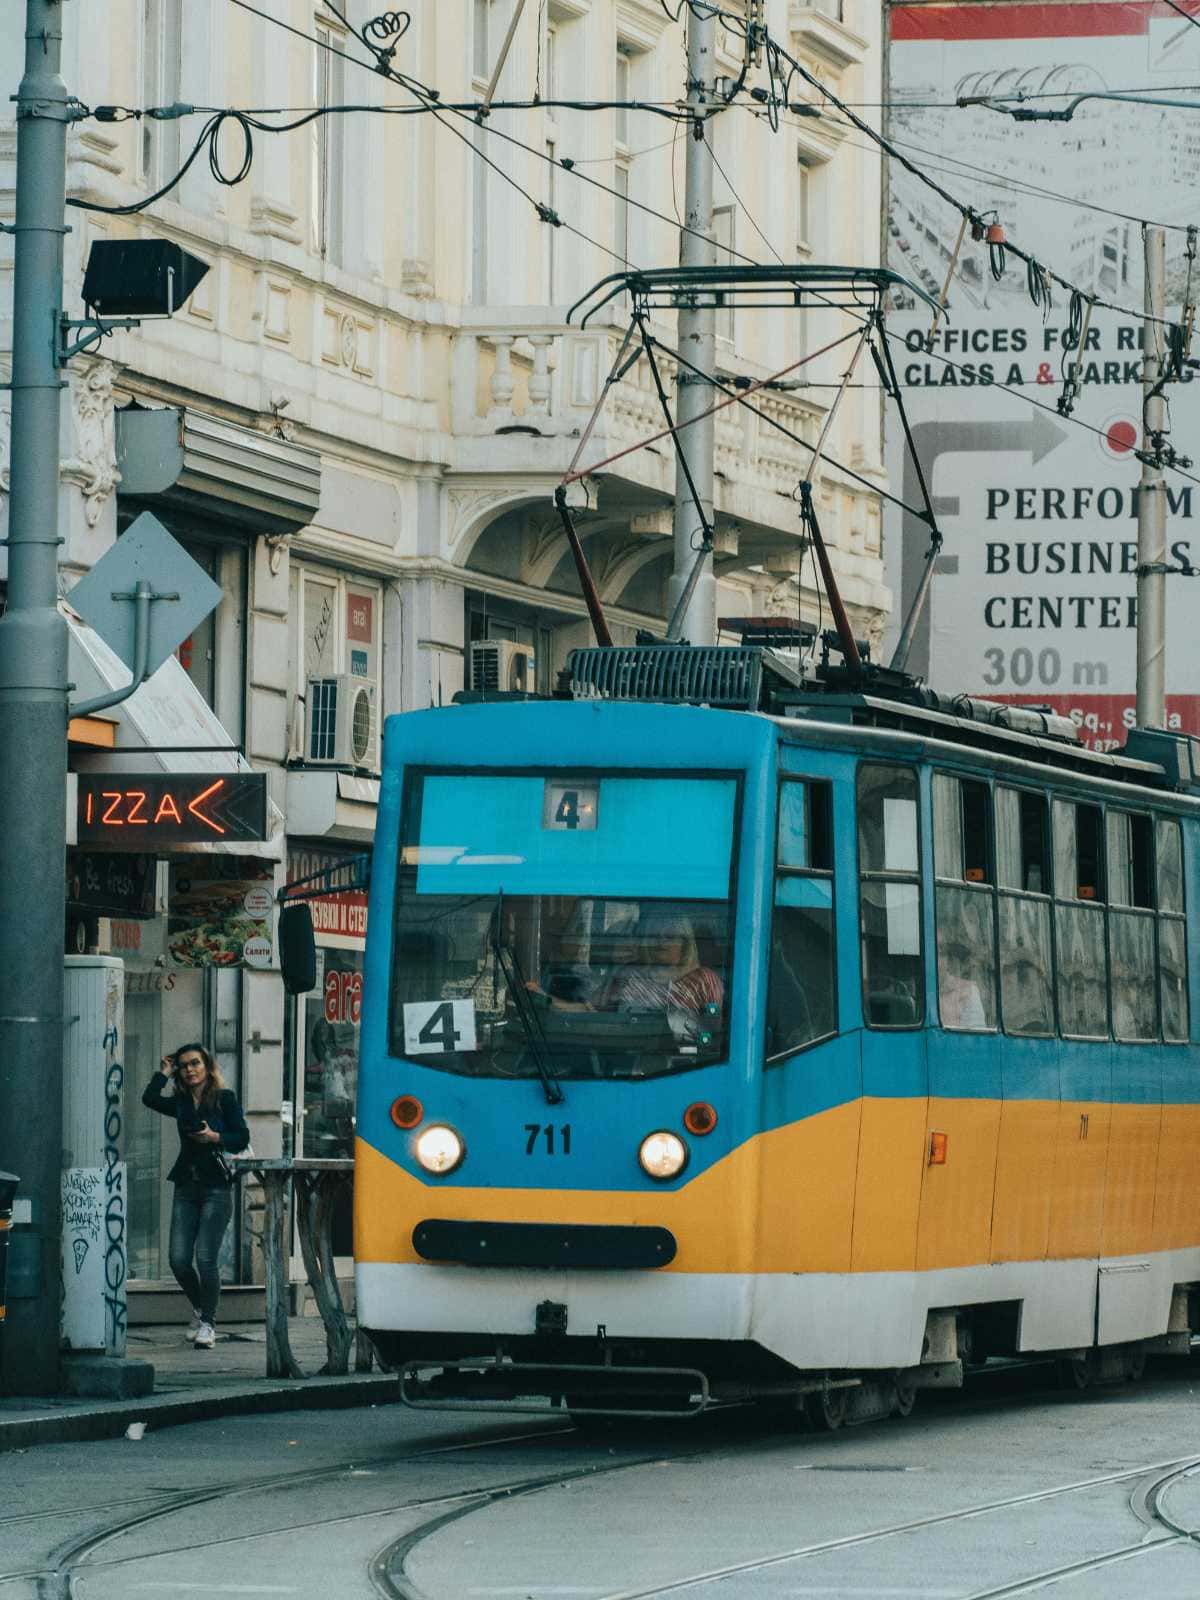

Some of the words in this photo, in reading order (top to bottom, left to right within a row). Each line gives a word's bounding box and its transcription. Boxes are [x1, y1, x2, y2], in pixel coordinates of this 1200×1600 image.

[904, 329, 1027, 352] OFFICES
[1043, 327, 1101, 351] FOR
[904, 363, 995, 387] CLASS
[1005, 363, 1024, 385] A
[1036, 362, 1054, 385] &
[985, 541, 1191, 574] BUSINES
[982, 647, 1062, 686] 300
[1072, 660, 1109, 685] m
[86, 792, 182, 825] IZZA
[555, 791, 580, 829] 4
[325, 970, 363, 1025] ara
[418, 1002, 461, 1051] 4
[524, 1123, 571, 1156] 711
